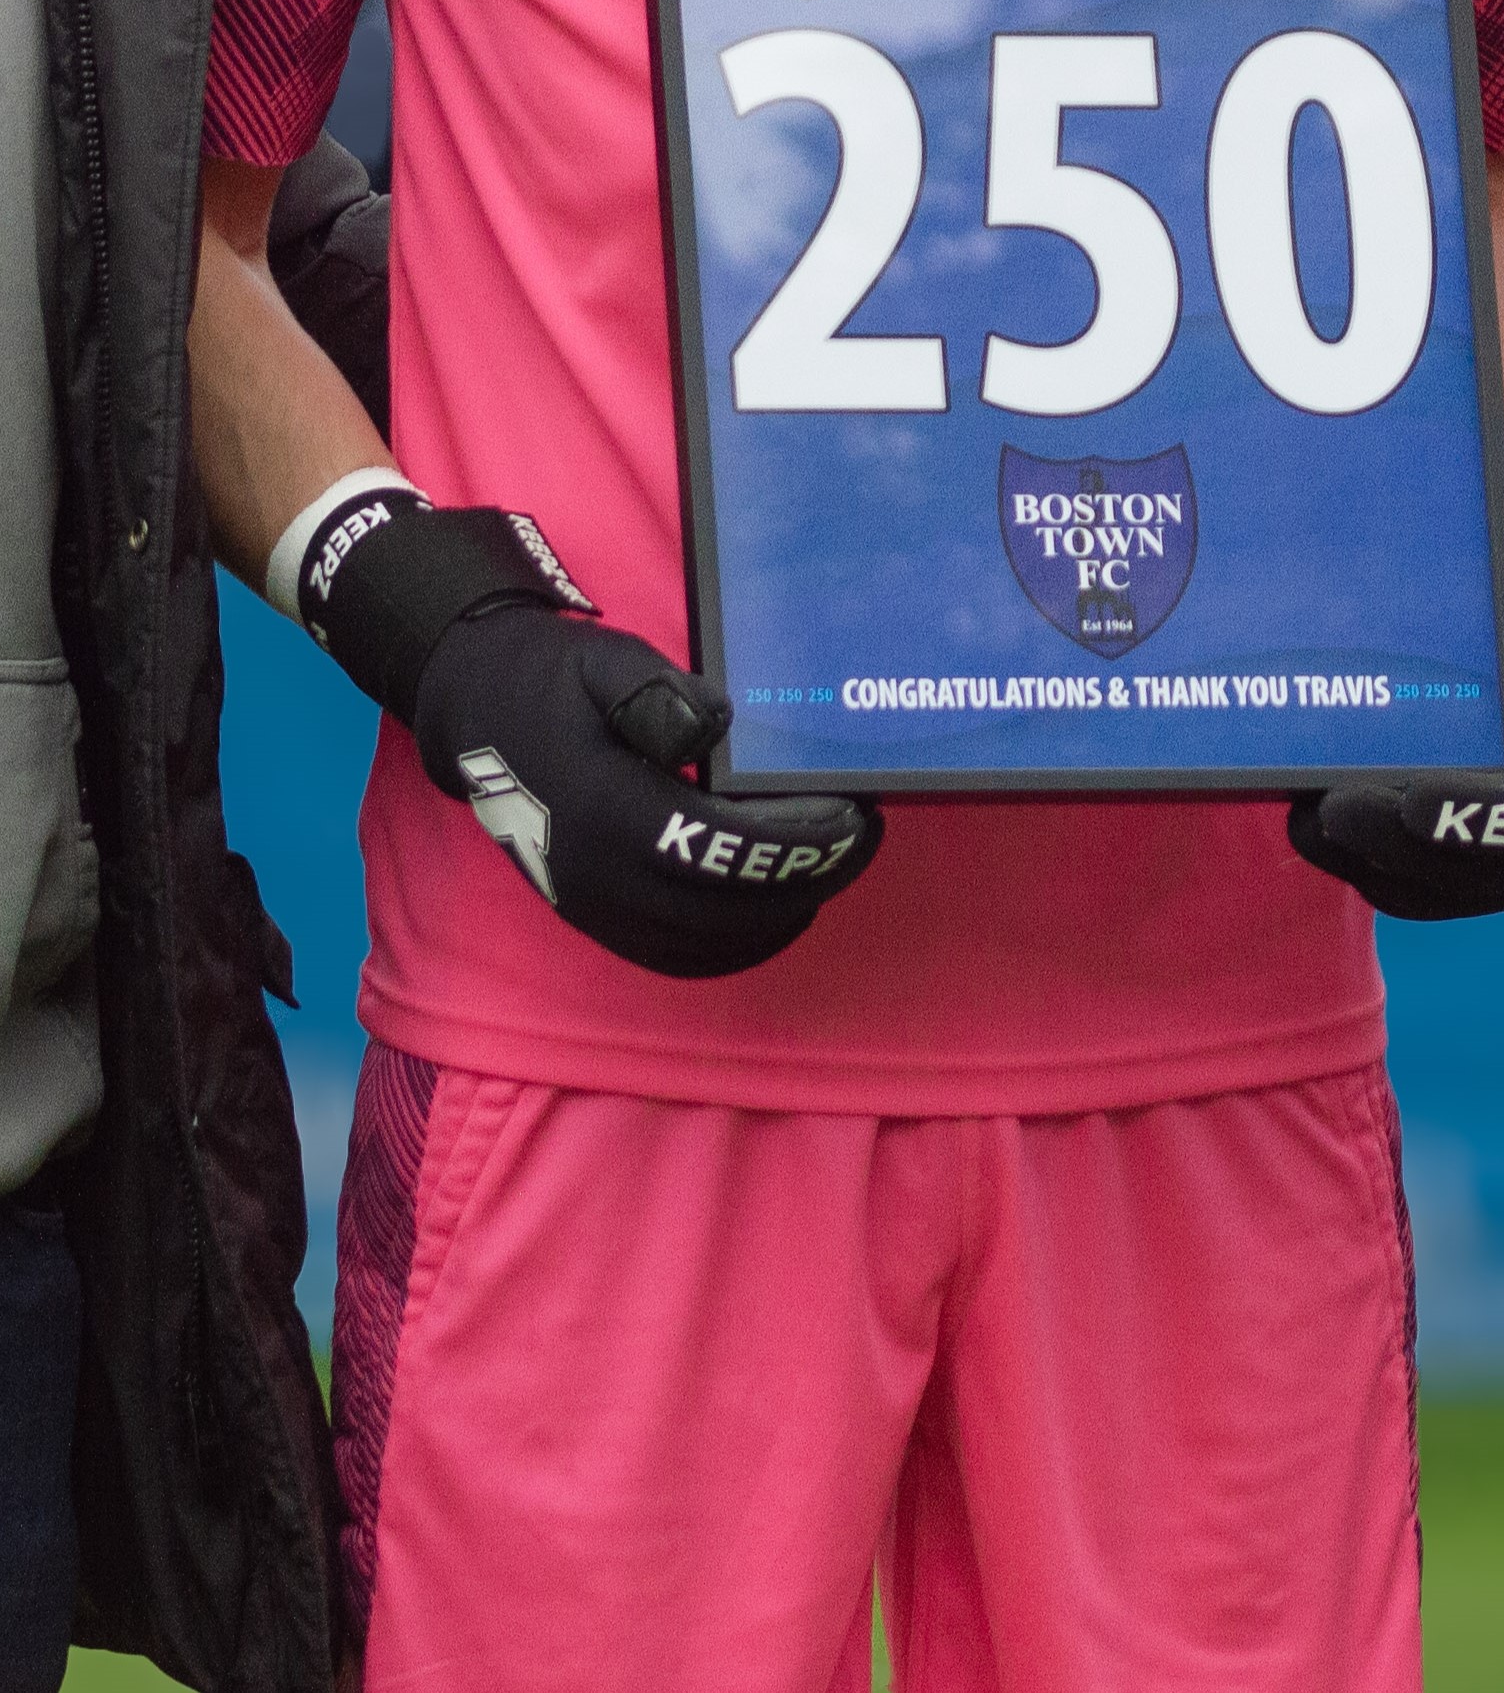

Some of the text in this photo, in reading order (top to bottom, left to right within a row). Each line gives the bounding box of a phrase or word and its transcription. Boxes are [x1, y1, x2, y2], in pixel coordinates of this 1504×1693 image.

[718, 28, 1438, 417] 250
[1012, 493, 1183, 526] BOSTON
[310, 501, 392, 603] KEEPZ
[1035, 526, 1164, 558] TOWN
[1076, 559, 1131, 591] FC
[1082, 619, 1134, 632] Est 1964
[746, 674, 1481, 709] 250 250 250 CONGRATULATIONS & THANK YOU TRAVIS 250 250 250
[656, 810, 856, 883] KEEPZ
